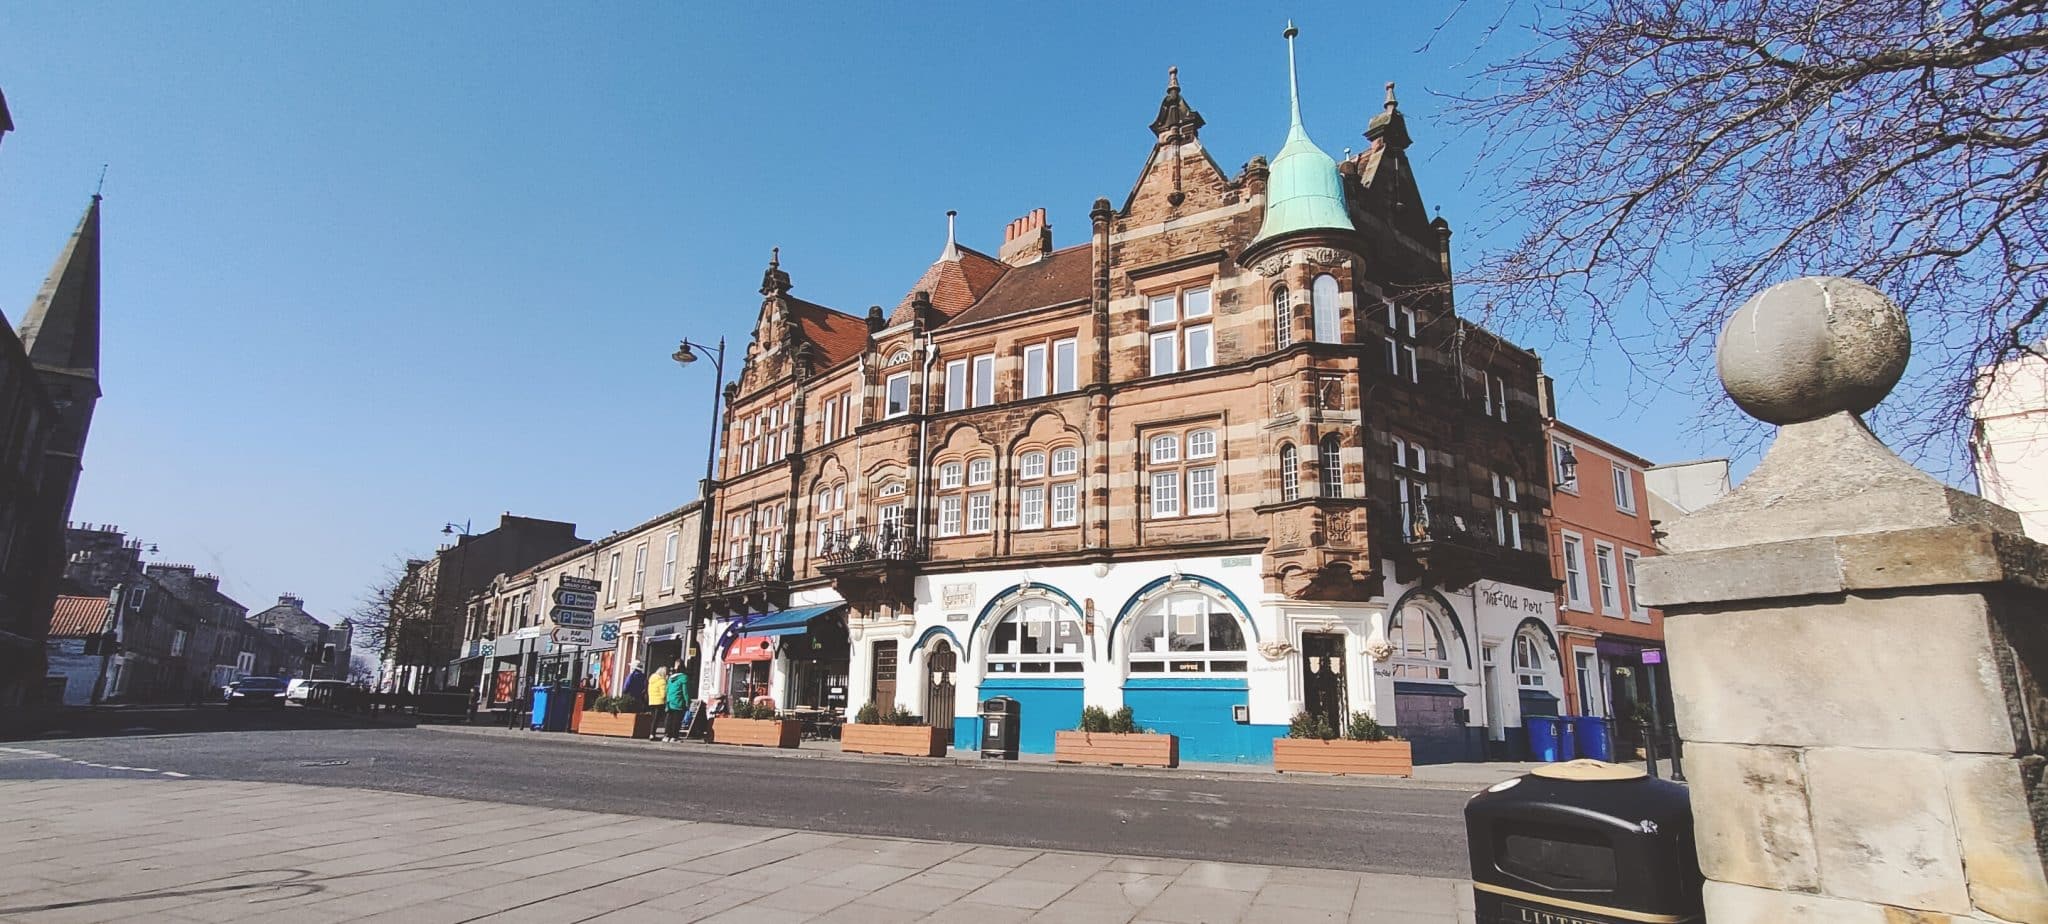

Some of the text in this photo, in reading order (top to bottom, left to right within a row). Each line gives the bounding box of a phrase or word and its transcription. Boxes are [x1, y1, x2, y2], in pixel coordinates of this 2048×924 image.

[1503, 594, 1519, 609] Old
[1523, 598, 1543, 615] Port
[1521, 909, 1595, 924] LITT
